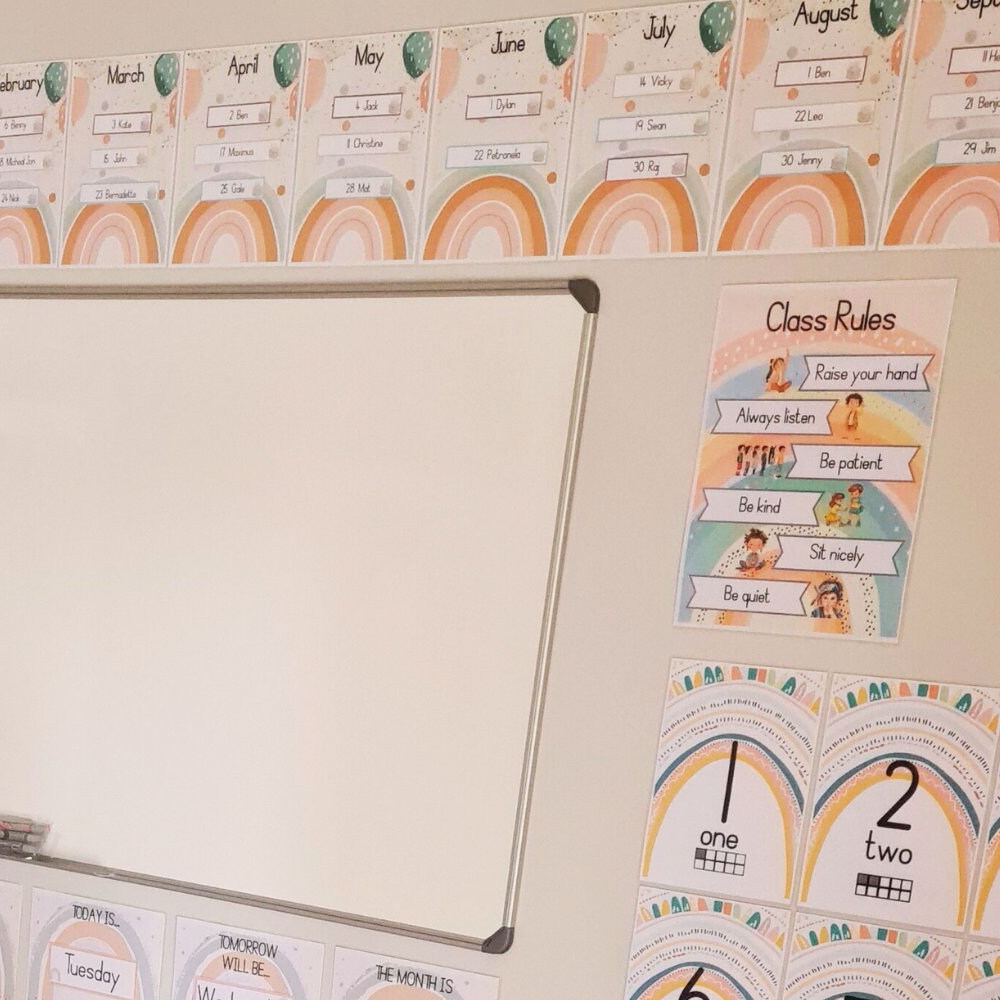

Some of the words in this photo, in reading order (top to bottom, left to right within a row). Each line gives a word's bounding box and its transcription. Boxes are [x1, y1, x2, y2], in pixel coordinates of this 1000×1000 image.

[793, 2, 858, 33] August
[643, 16, 676, 47] July
[491, 31, 525, 55] June
[355, 44, 384, 72] May
[107, 65, 144, 85] March
[228, 54, 258, 83] April
[815, 67, 831, 78] Ben
[651, 76, 673, 89] Vicky
[236, 110, 248, 119] Ben
[496, 100, 516, 112] Dylan
[635, 120, 643, 132] 19
[647, 120, 667, 131] Sean
[795, 111, 806, 122] 22
[807, 111, 823, 121] Leo
[474, 149, 484, 160] 22
[963, 142, 976, 155] 29
[981, 142, 996, 154] Jim
[632, 161, 644, 173] 30
[647, 160, 660, 174] Raj
[781, 154, 793, 166] 30
[798, 153, 823, 167] Jenny
[345, 183, 355, 193] 28
[767, 301, 827, 333] Class
[834, 299, 896, 332] Rules
[814, 363, 848, 382] Raise
[850, 367, 883, 386] your
[886, 363, 918, 381] hand
[735, 408, 781, 431] Always
[783, 408, 816, 424] listen
[819, 452, 836, 469] Be
[838, 454, 883, 472] patient
[738, 497, 754, 513] Be
[756, 497, 781, 514] kind
[809, 544, 827, 562] Sit
[830, 546, 864, 568] nicely
[723, 585, 738, 602] Be
[742, 588, 770, 607] quiet
[720, 740, 738, 824] 1
[876, 759, 920, 831] 2
[700, 830, 739, 850] one
[865, 829, 913, 865] two
[72, 904, 101, 923] TODAY
[218, 934, 279, 960] TOMORROW
[65, 952, 121, 993] Tuesday
[222, 955, 247, 975] WILL
[376, 964, 394, 983] THE
[395, 967, 437, 991] MONTH
[438, 976, 454, 994] IS
